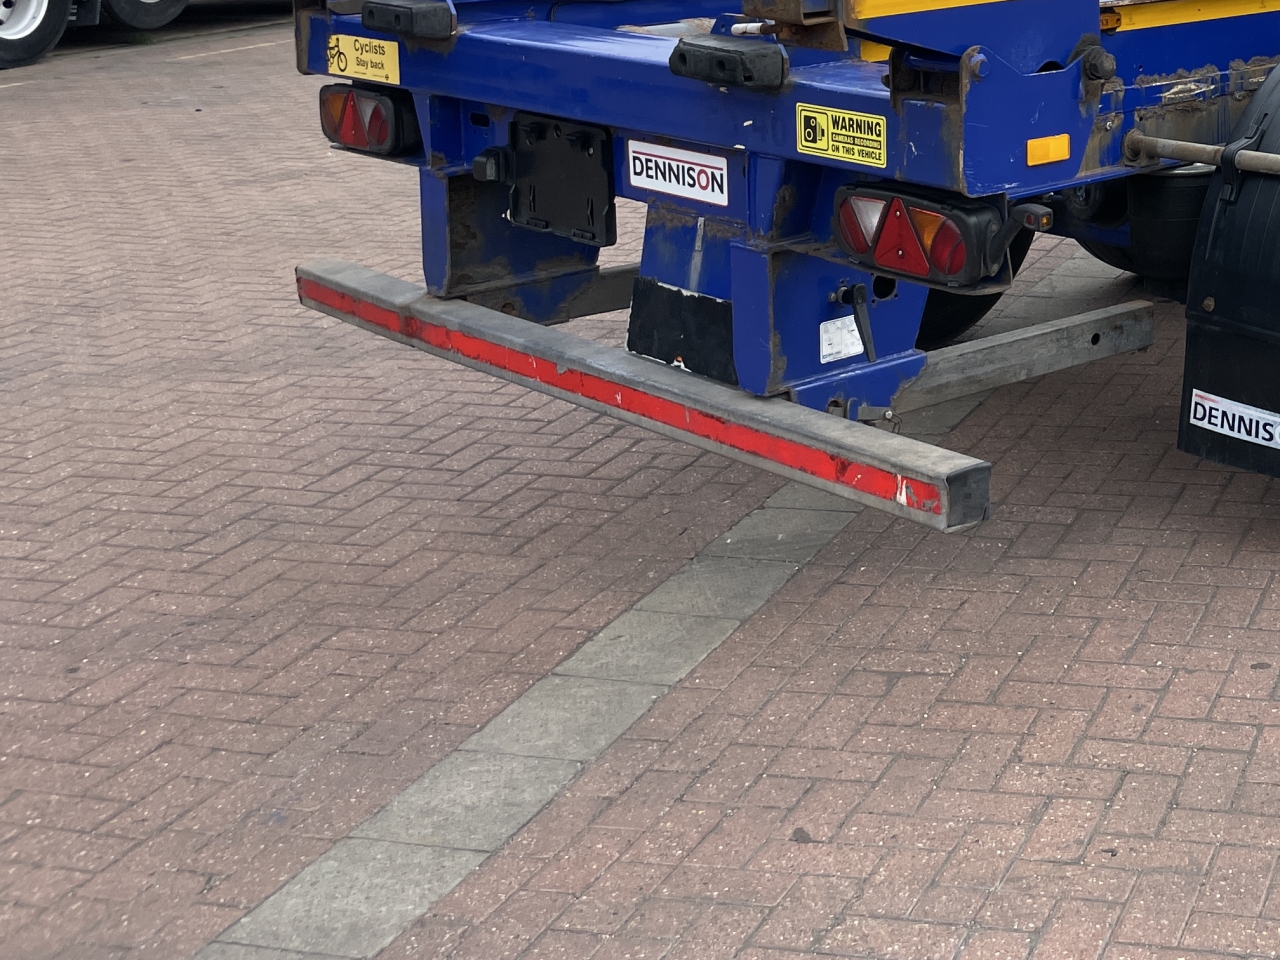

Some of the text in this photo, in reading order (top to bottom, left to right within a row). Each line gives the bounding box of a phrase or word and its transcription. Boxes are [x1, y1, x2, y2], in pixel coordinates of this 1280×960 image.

[354, 38, 386, 56] Cyclists
[355, 56, 385, 70] Stay back
[831, 114, 882, 138] WARNING
[832, 133, 881, 148] CAMERAS RECORDING
[831, 143, 882, 161] ON THIS VEHICLE
[632, 155, 724, 195] DENNISON
